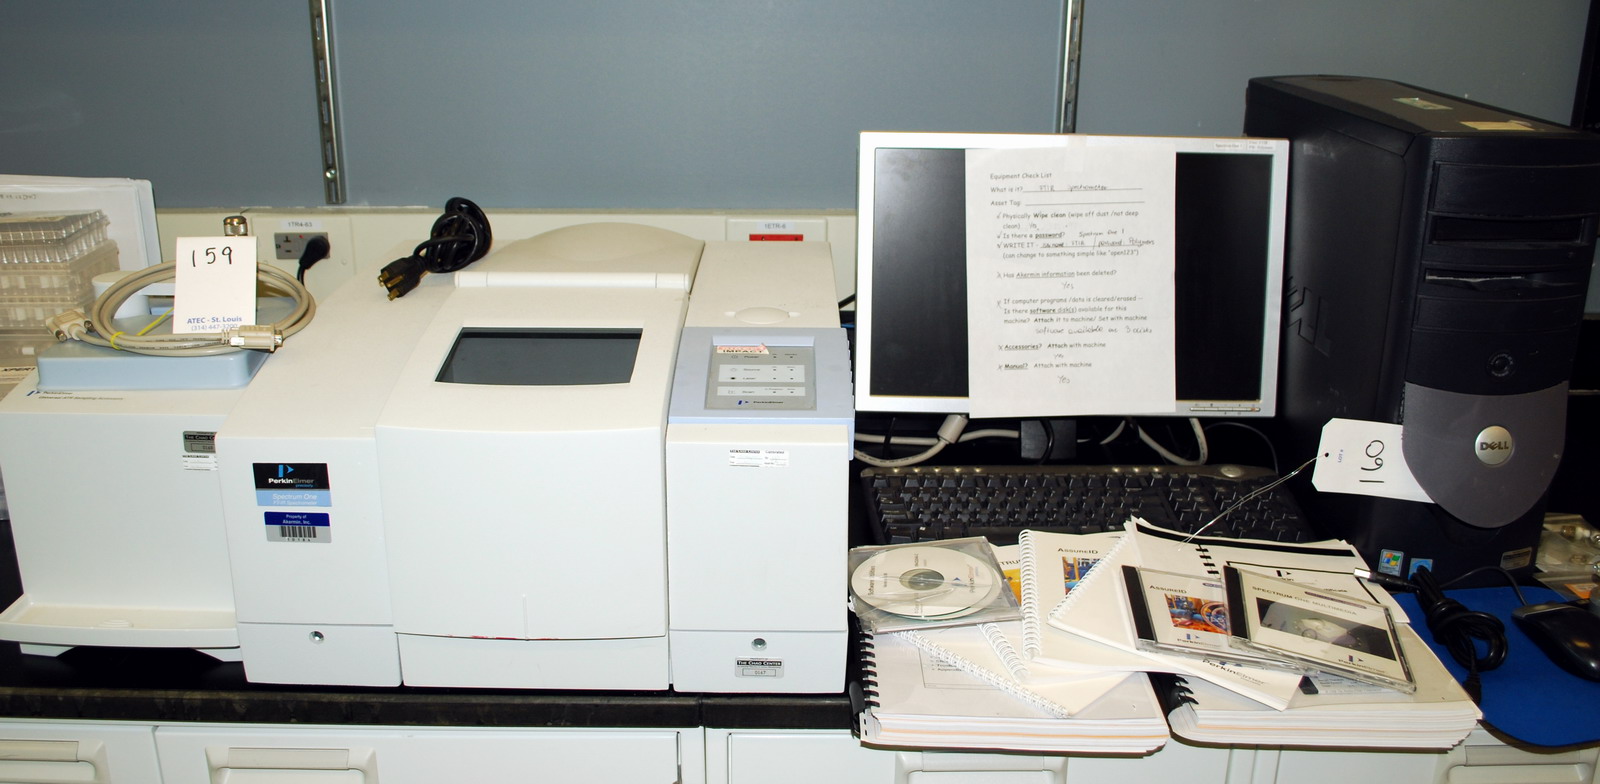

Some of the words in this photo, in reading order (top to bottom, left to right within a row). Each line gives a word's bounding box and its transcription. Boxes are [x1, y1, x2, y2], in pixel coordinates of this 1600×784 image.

[192, 246, 232, 267] 159
[1058, 375, 1070, 384] Yes
[1480, 441, 1509, 450] DELL
[1359, 440, 1384, 483] 160
[1252, 586, 1293, 599] SPECTRUM
[1312, 601, 1357, 615] MULTIMEDIA
[1203, 659, 1264, 684] PerkinElmer
